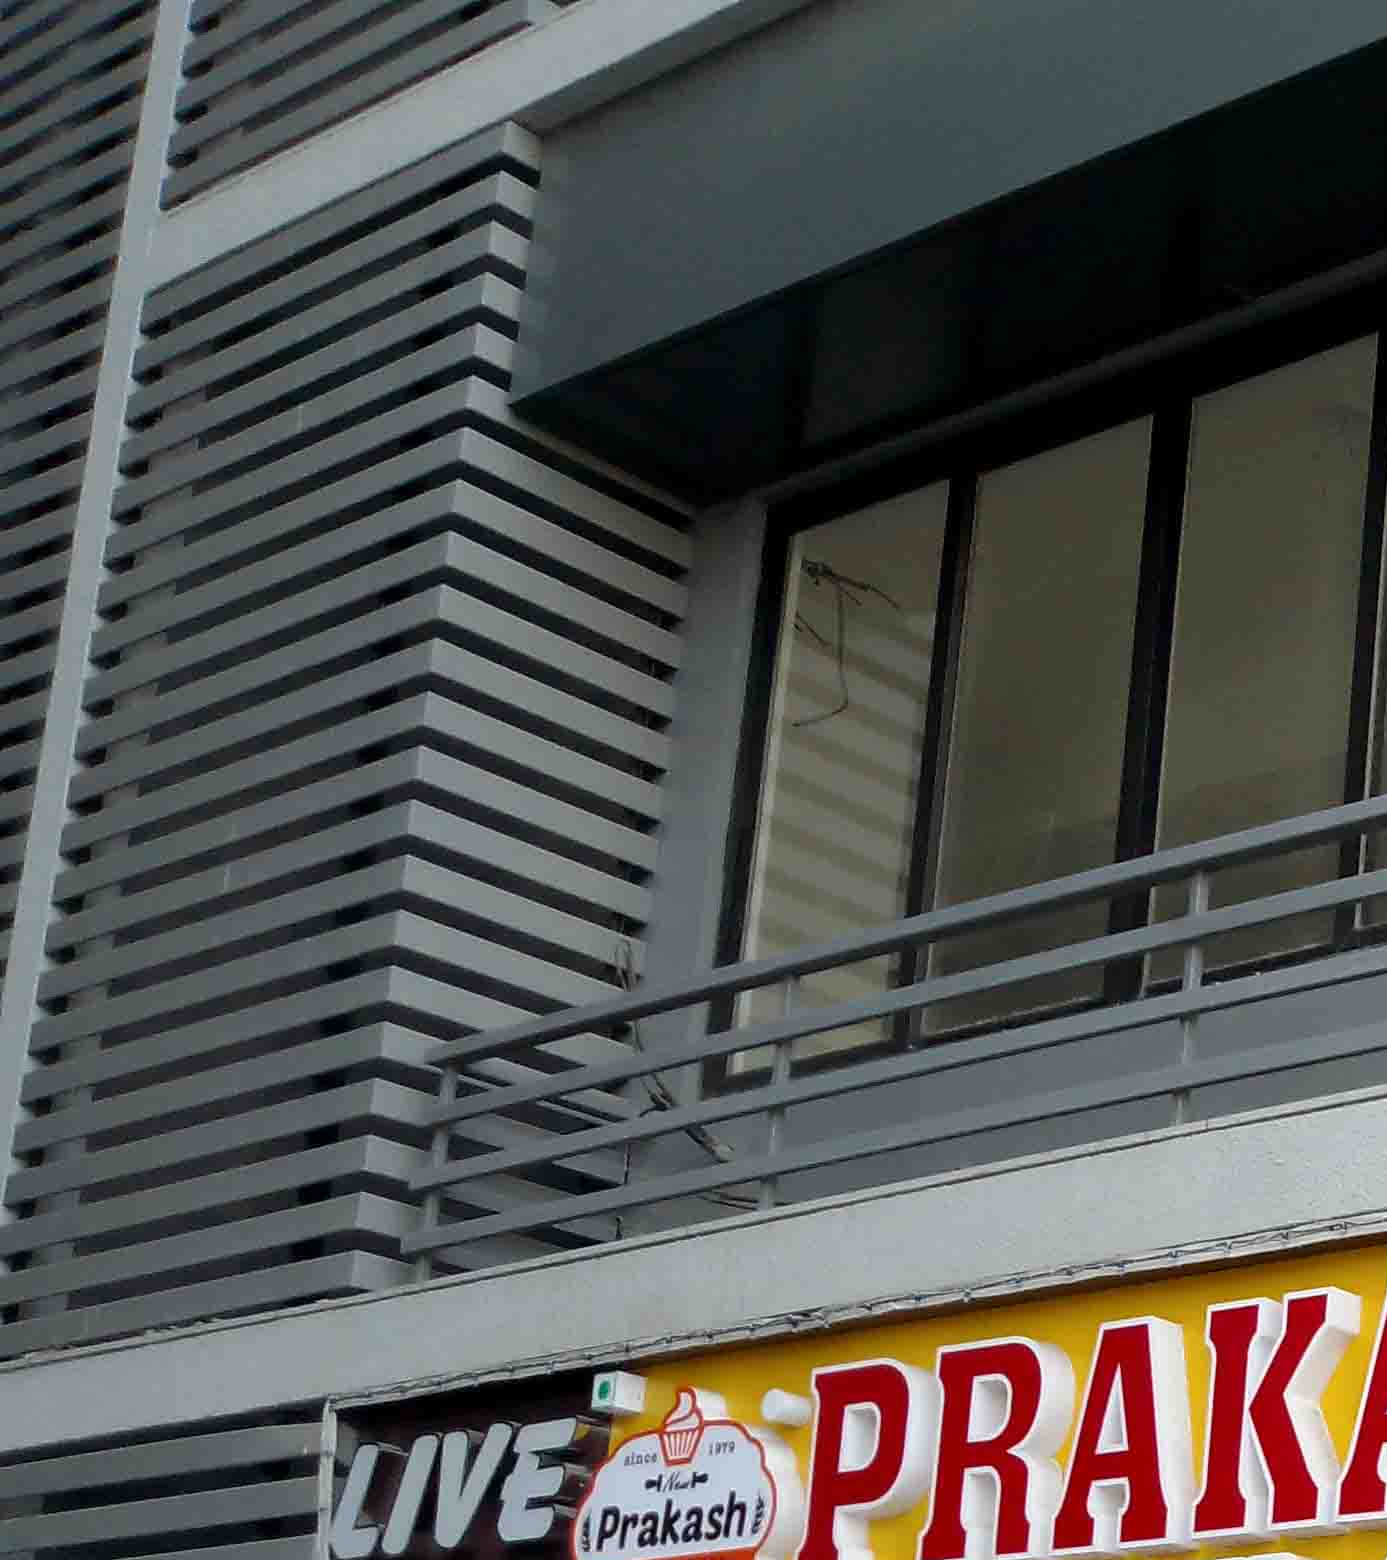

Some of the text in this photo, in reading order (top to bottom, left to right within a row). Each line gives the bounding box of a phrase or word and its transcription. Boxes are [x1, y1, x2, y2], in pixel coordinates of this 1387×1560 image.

[624, 1441, 736, 1466] since 1979
[596, 1490, 746, 1551] Prakash
